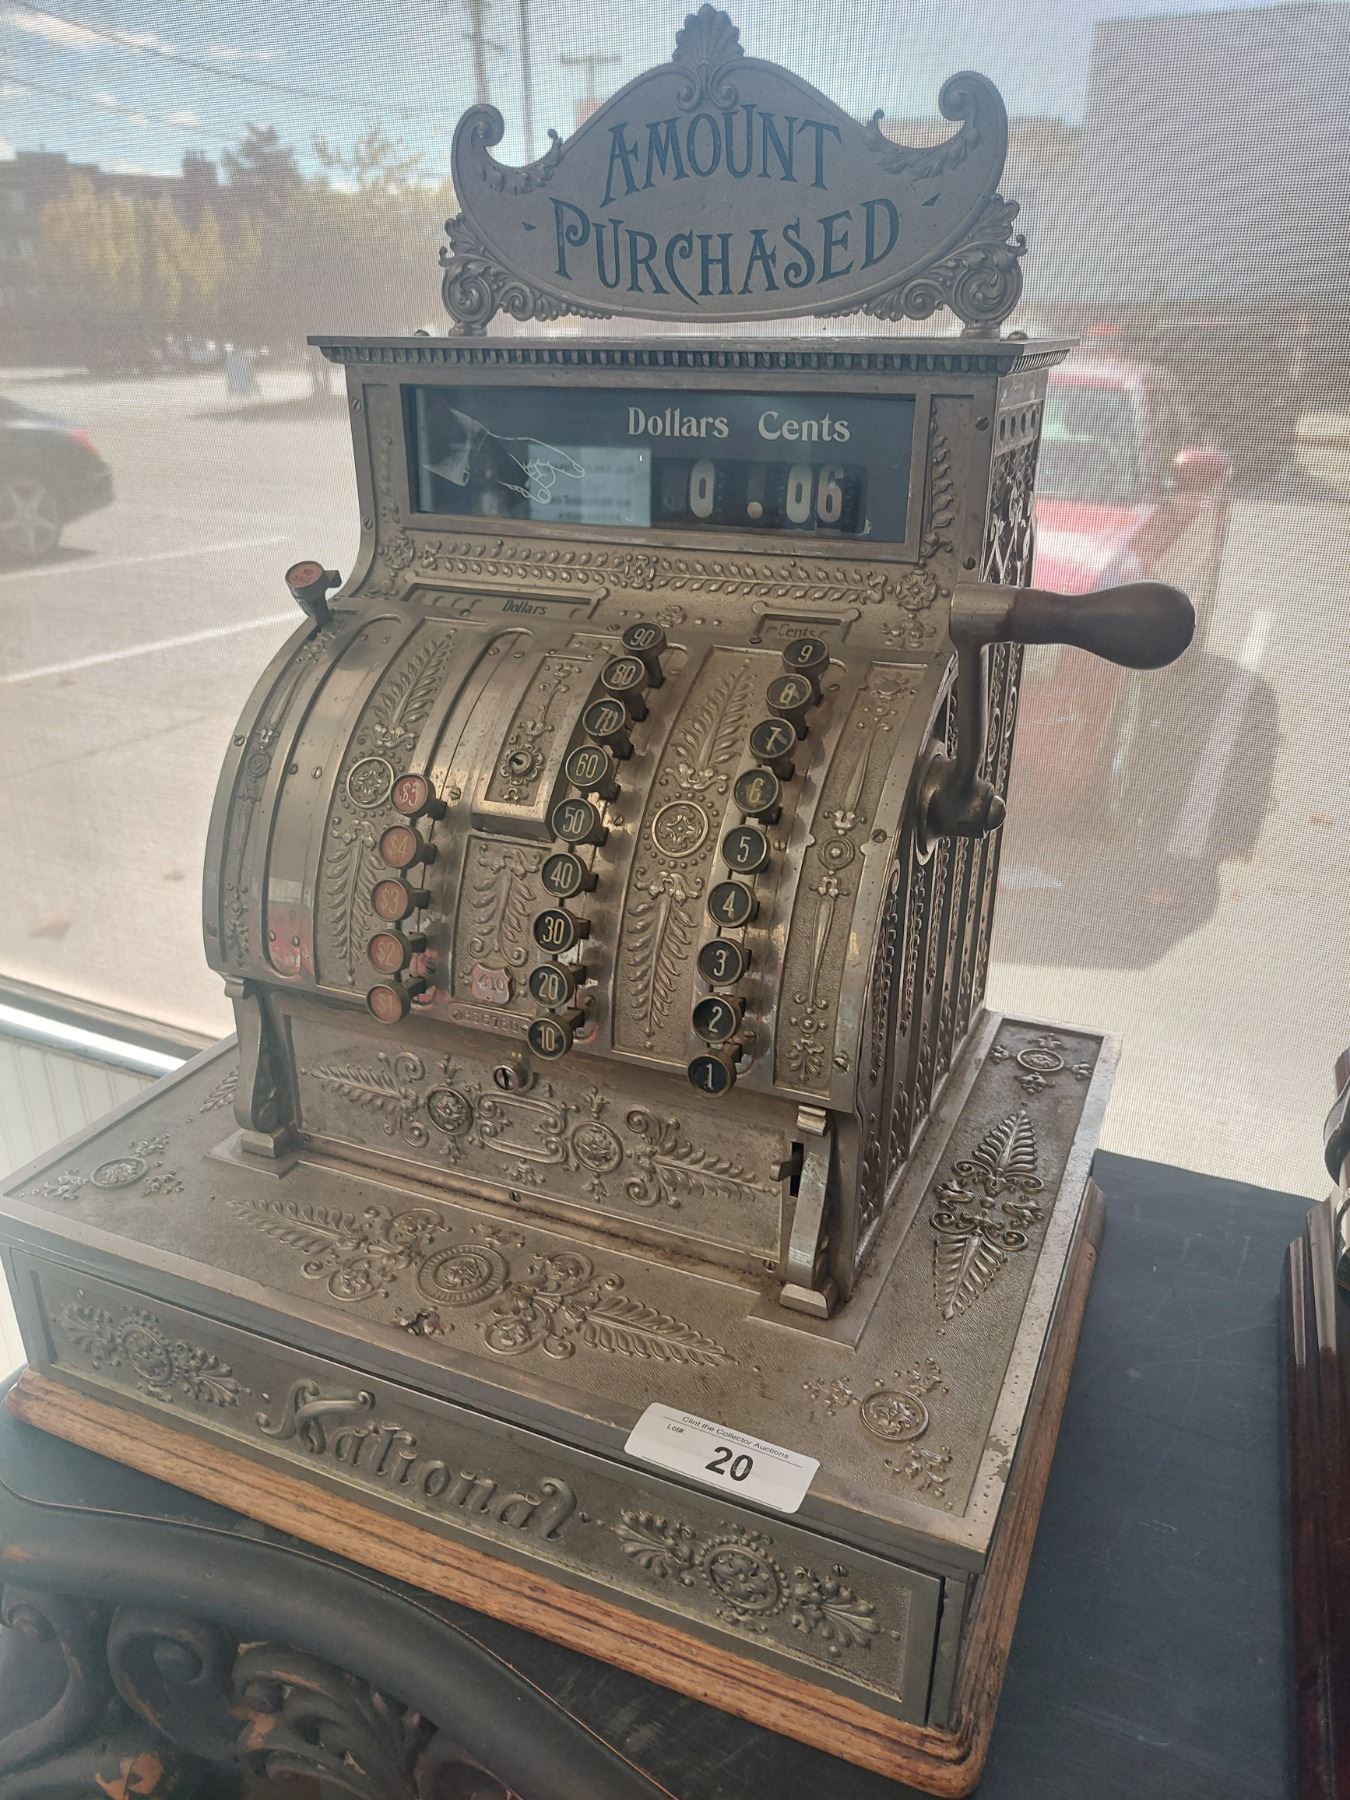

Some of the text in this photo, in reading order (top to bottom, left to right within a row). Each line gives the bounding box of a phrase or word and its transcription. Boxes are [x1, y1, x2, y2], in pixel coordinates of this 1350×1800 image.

[600, 104, 843, 207] AMOUNT
[549, 198, 900, 305] PURCHASED
[628, 406, 850, 442] Dollars Cents
[502, 599, 547, 615] Dollars
[631, 627, 656, 647] 90
[777, 623, 816, 638] Cents
[798, 644, 813, 662] 9
[611, 664, 635, 684] 80
[779, 682, 797, 705] 8
[600, 707, 618, 731] 70
[766, 726, 783, 752] 7
[576, 753, 599, 778] 60
[750, 777, 764, 805] 6
[562, 807, 585, 834] 50
[388, 834, 408, 858] $4
[737, 836, 751, 863] 5
[550, 862, 572, 889] 40
[380, 887, 400, 914] $3
[722, 890, 736, 918] 4
[542, 916, 565, 944] 30
[376, 941, 395, 967] $2
[713, 949, 726, 977] 3
[538, 971, 559, 1000] 20
[708, 1005, 721, 1033] 2
[538, 1026, 556, 1051] 10
[706, 1063, 713, 1090] 1
[682, 1416, 790, 1459] Clint the Collector Auctions
[255, 1378, 578, 1541] National
[705, 1446, 754, 1482] 20
